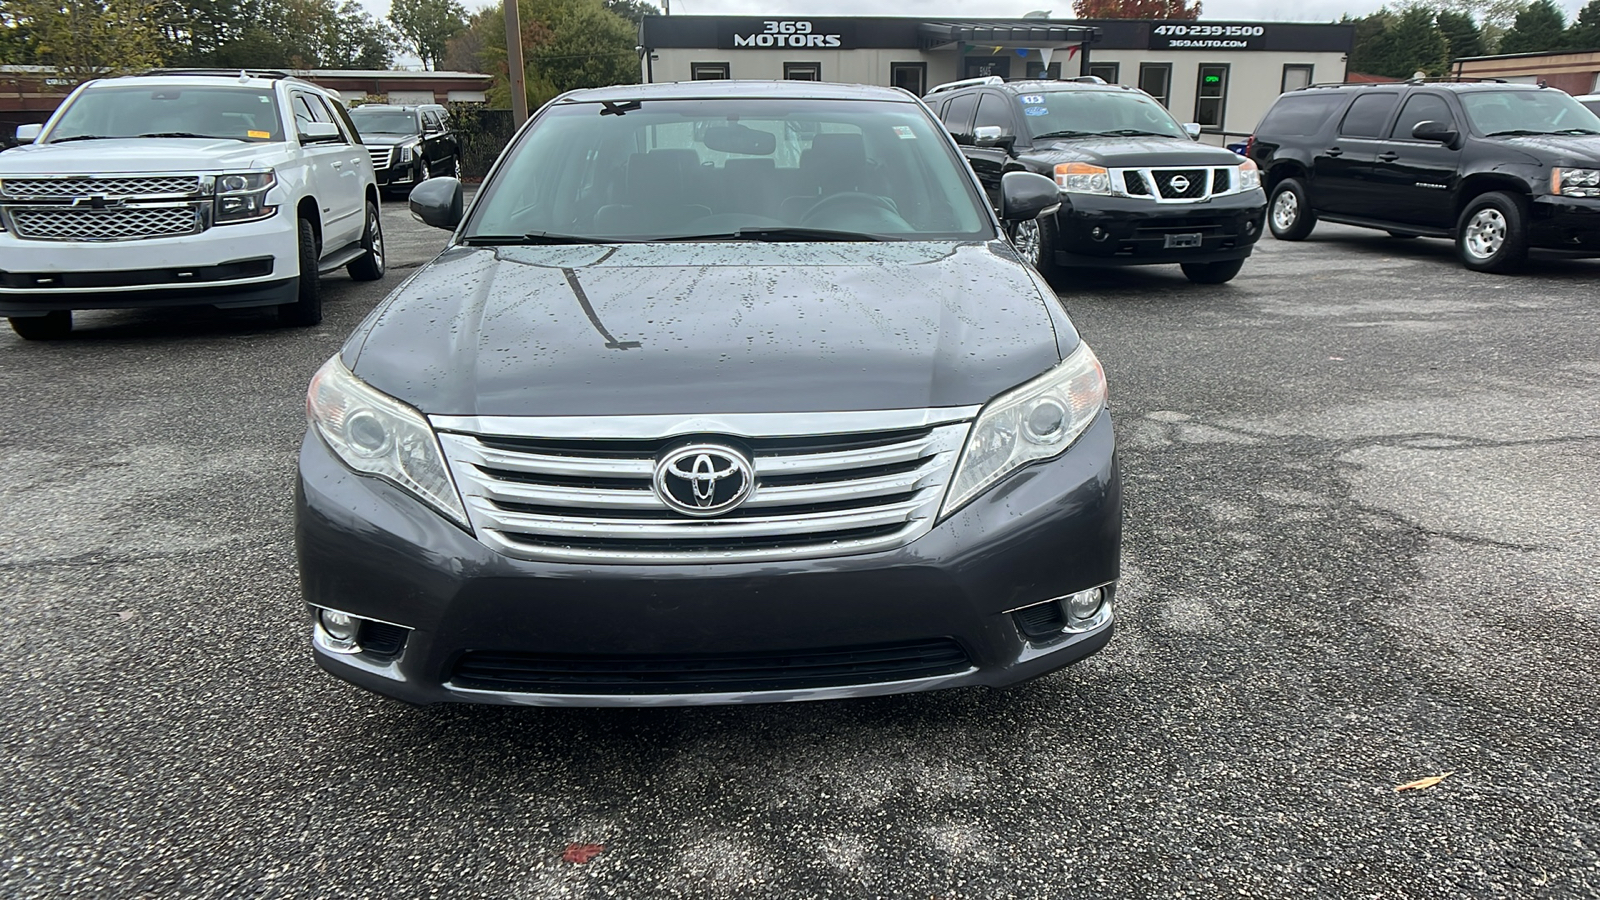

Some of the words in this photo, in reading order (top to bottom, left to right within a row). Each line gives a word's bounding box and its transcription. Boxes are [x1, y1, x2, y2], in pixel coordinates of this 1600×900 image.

[763, 21, 812, 34] 369
[1154, 25, 1264, 36] 470-239-1500
[734, 33, 841, 47] MOTORS
[1169, 40, 1247, 48] 369AUTO.COM
